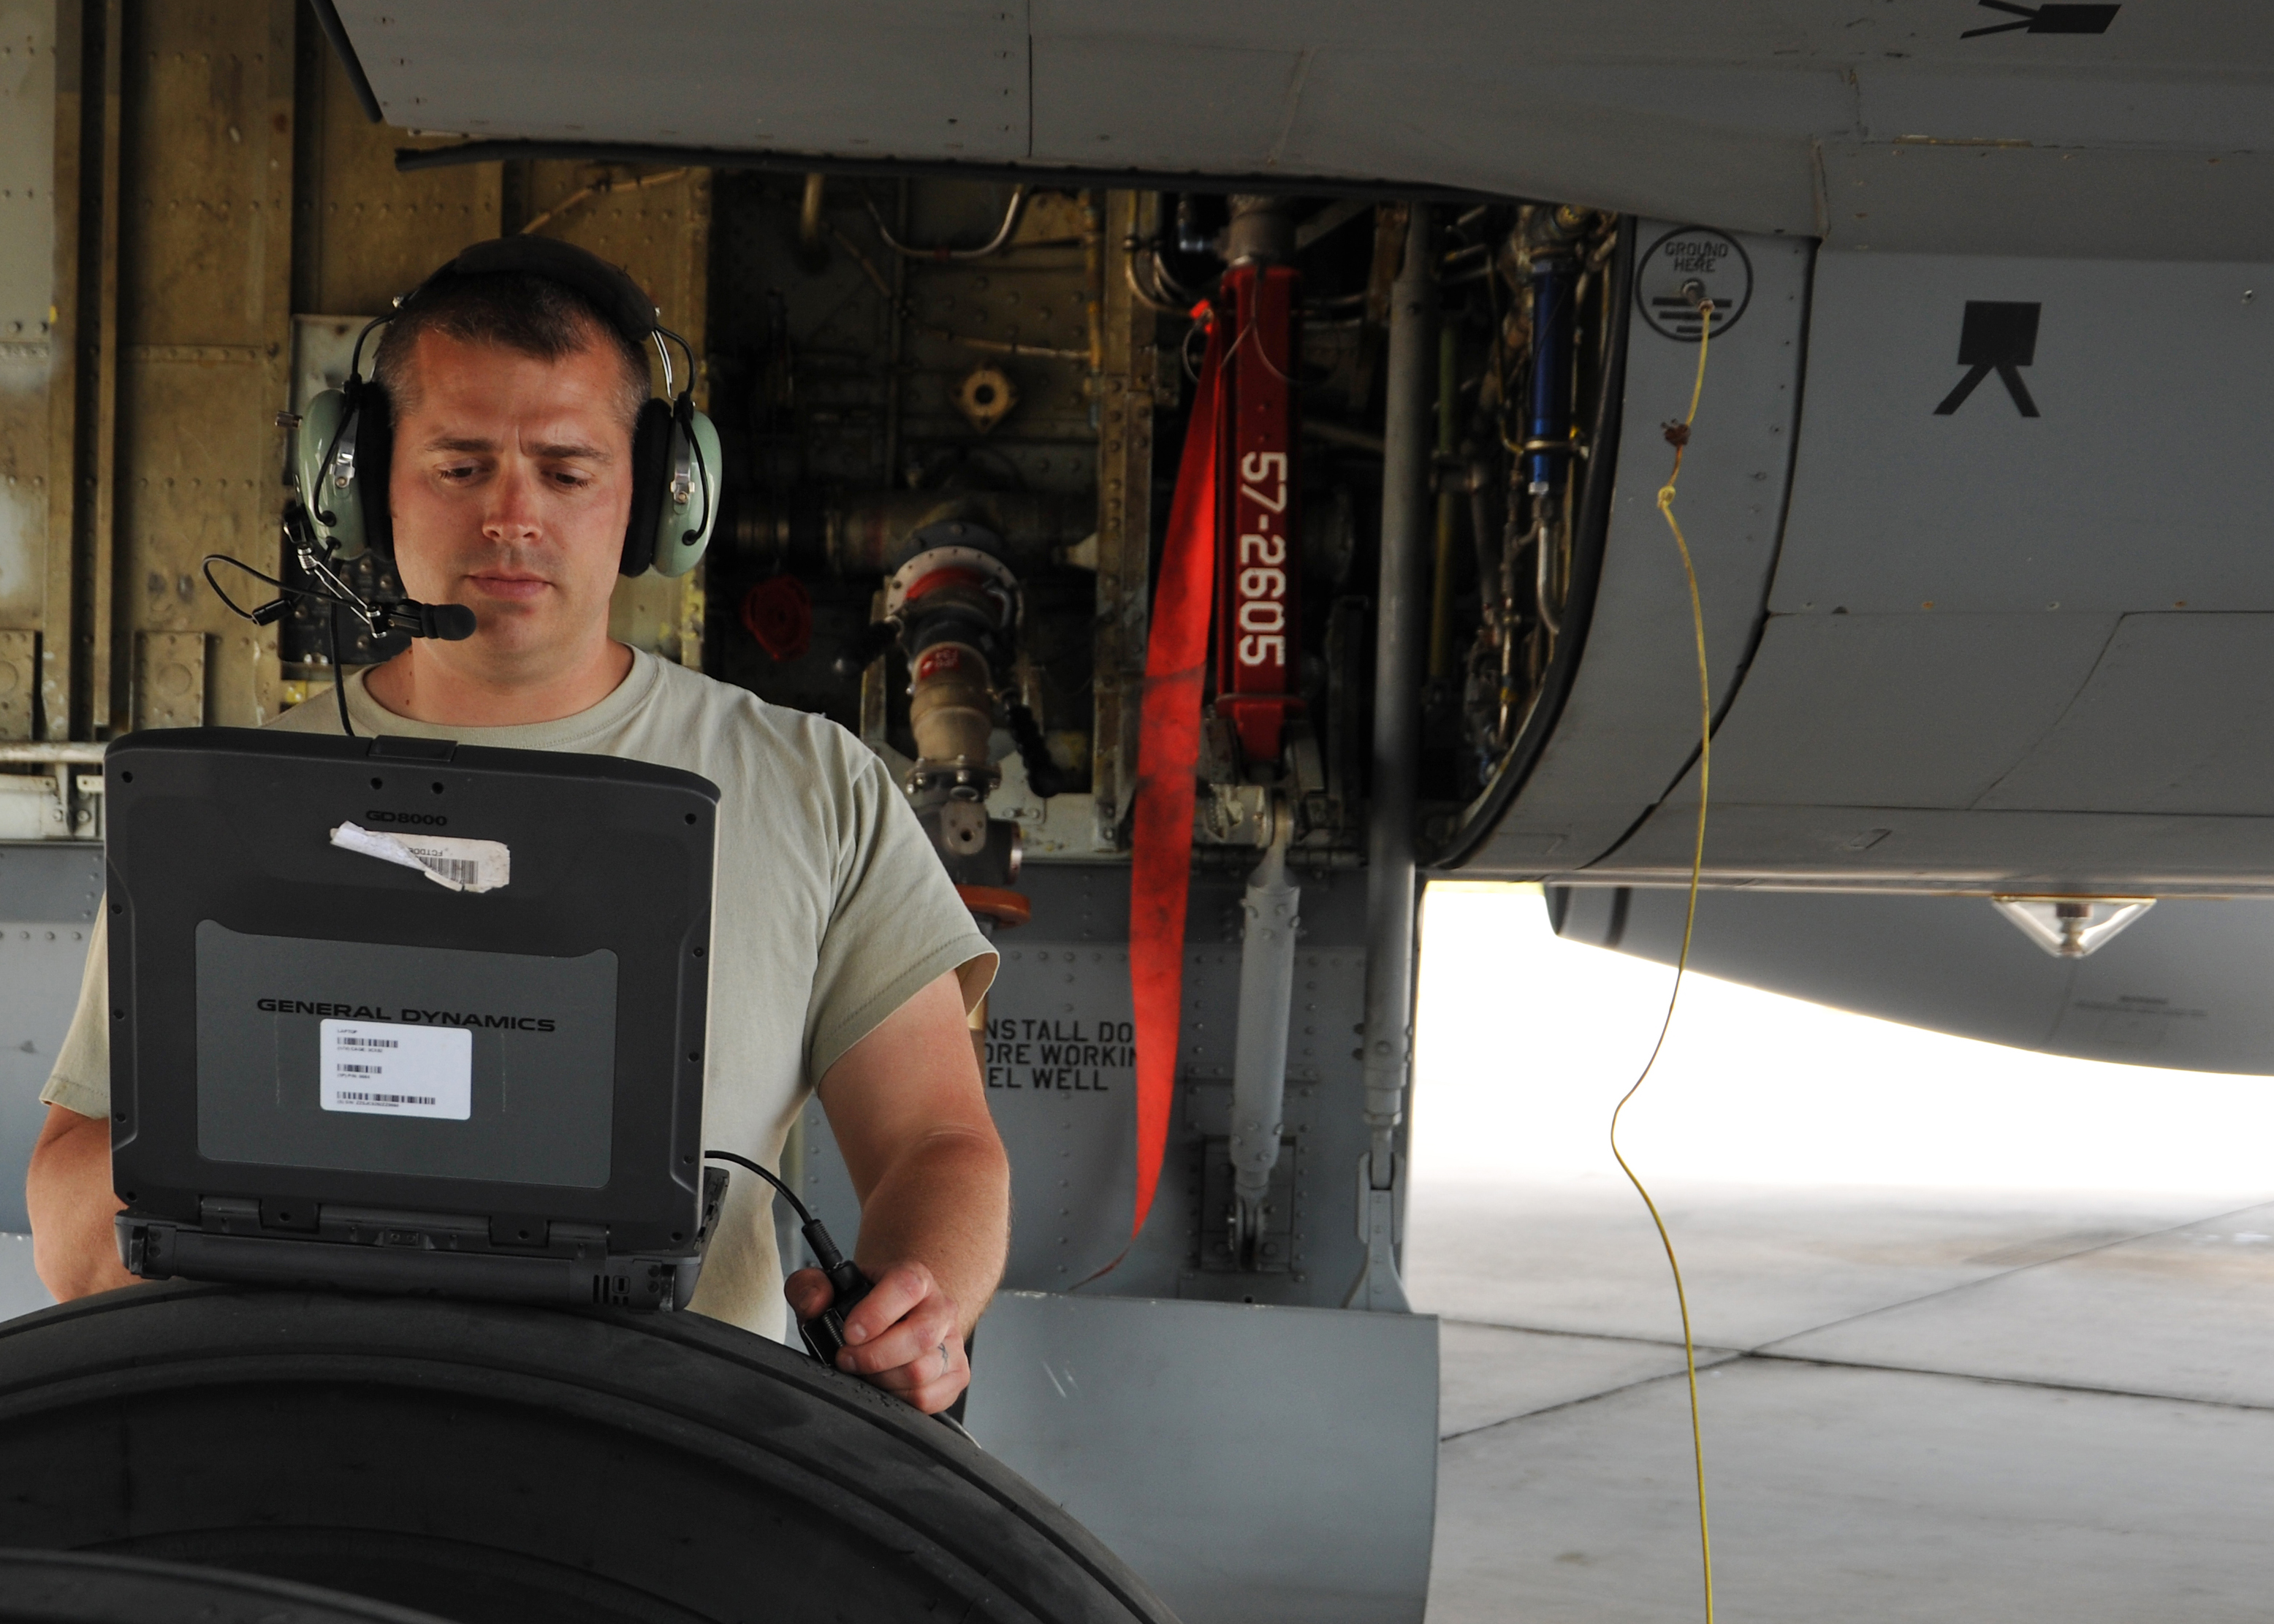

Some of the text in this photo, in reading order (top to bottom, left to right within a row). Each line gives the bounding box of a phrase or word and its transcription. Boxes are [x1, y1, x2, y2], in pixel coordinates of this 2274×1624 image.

[1665, 241, 1729, 258] GROUND
[1673, 256, 1716, 272] HERE
[1239, 451, 1288, 667] 57-2605
[366, 810, 447, 826] GD8000
[256, 998, 555, 1032] GENERAL DYNAMICS
[1032, 1067, 1109, 1091] WELL
